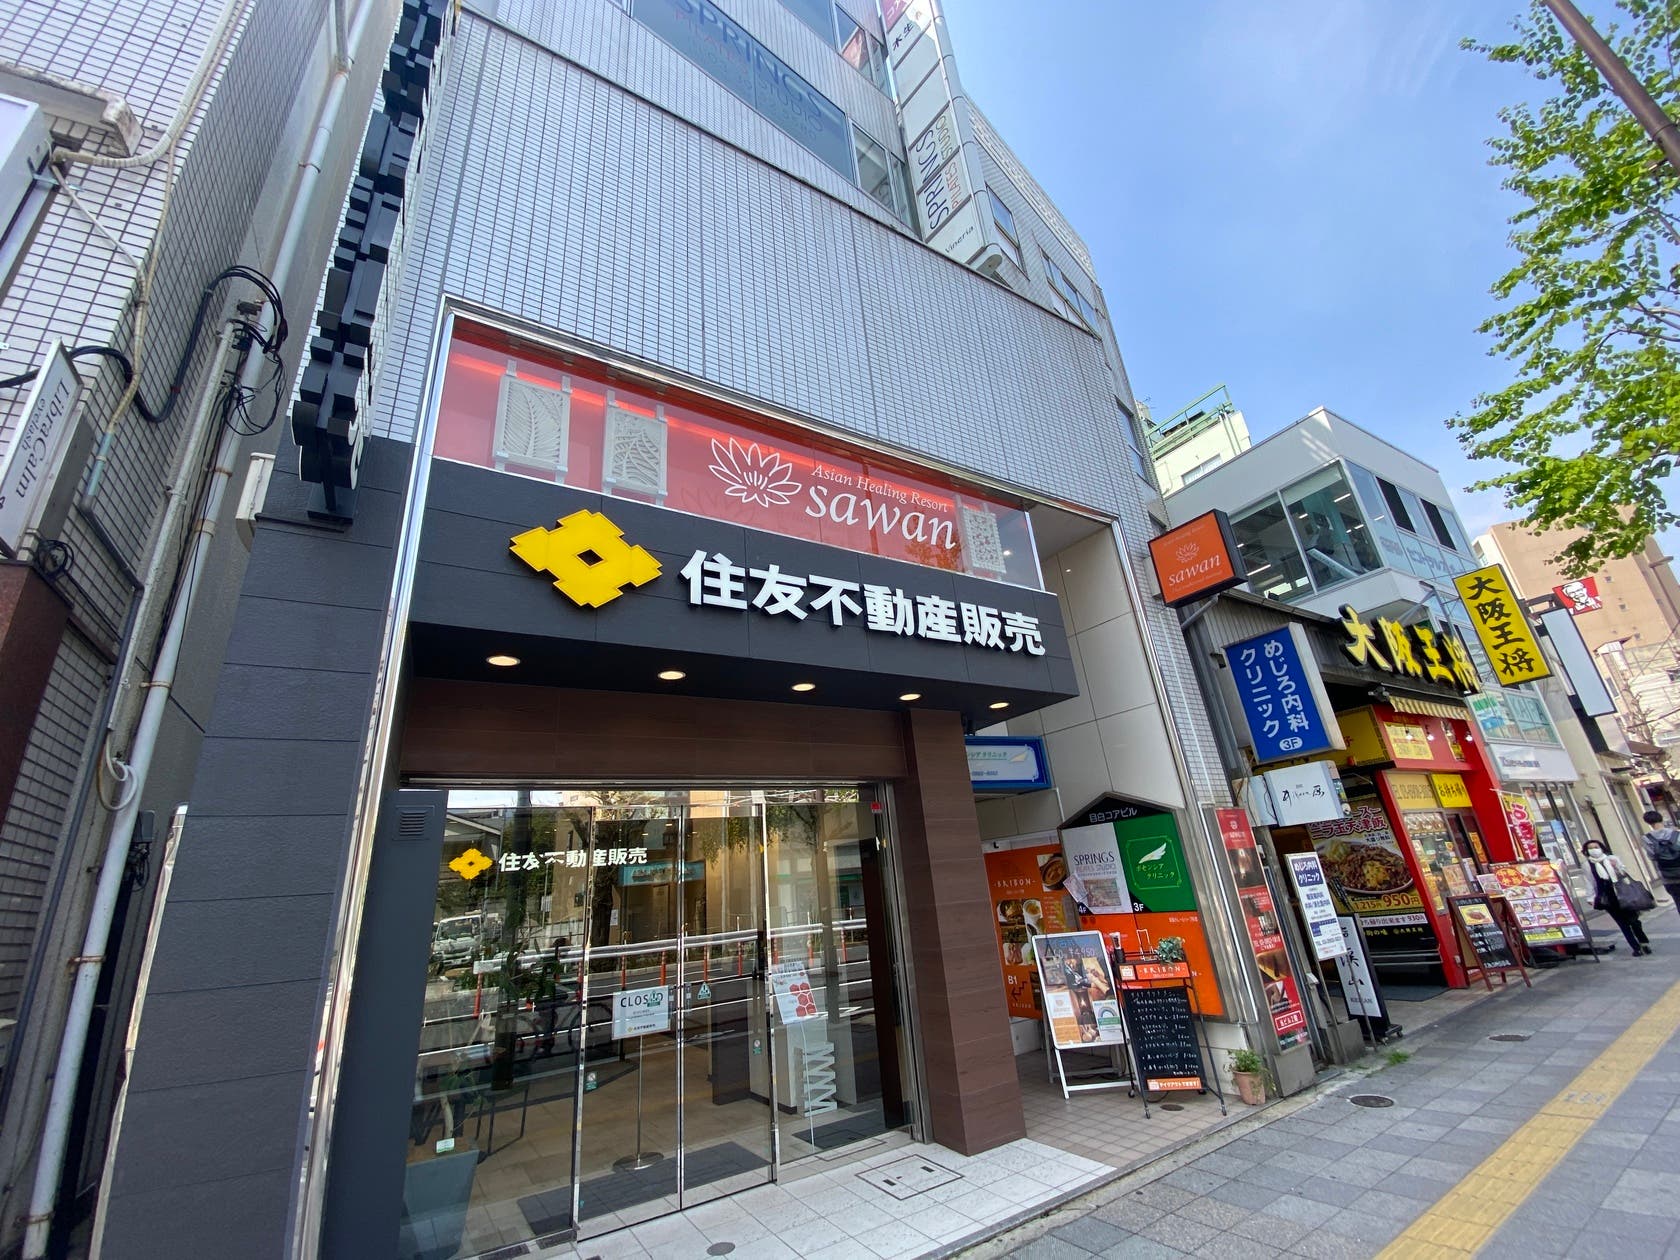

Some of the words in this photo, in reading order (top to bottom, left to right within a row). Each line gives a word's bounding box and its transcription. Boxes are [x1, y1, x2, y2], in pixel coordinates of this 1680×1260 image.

[915, 129, 950, 230] SPRINGS
[15, 378, 70, 499] LibraCalm
[22, 397, 46, 451] eyelash
[811, 464, 852, 487] Asian
[856, 477, 907, 504] Healing
[911, 491, 948, 513] Resort
[805, 485, 957, 550] sawan
[1168, 554, 1221, 587] sawan
[680, 549, 1046, 656] 住友不動産販売
[1466, 576, 1536, 677] 大阪王将
[1341, 604, 1482, 693] 大阪王将
[1240, 648, 1280, 738] クリニック
[1264, 639, 1310, 733] めじろ内科
[1283, 737, 1301, 750] 3F
[1089, 807, 1138, 823] 目白コアビル
[1073, 850, 1115, 866] SPRINGS
[1133, 903, 1144, 912] 3F
[1383, 893, 1420, 907] 950円
[620, 992, 664, 1008] CLOSD
